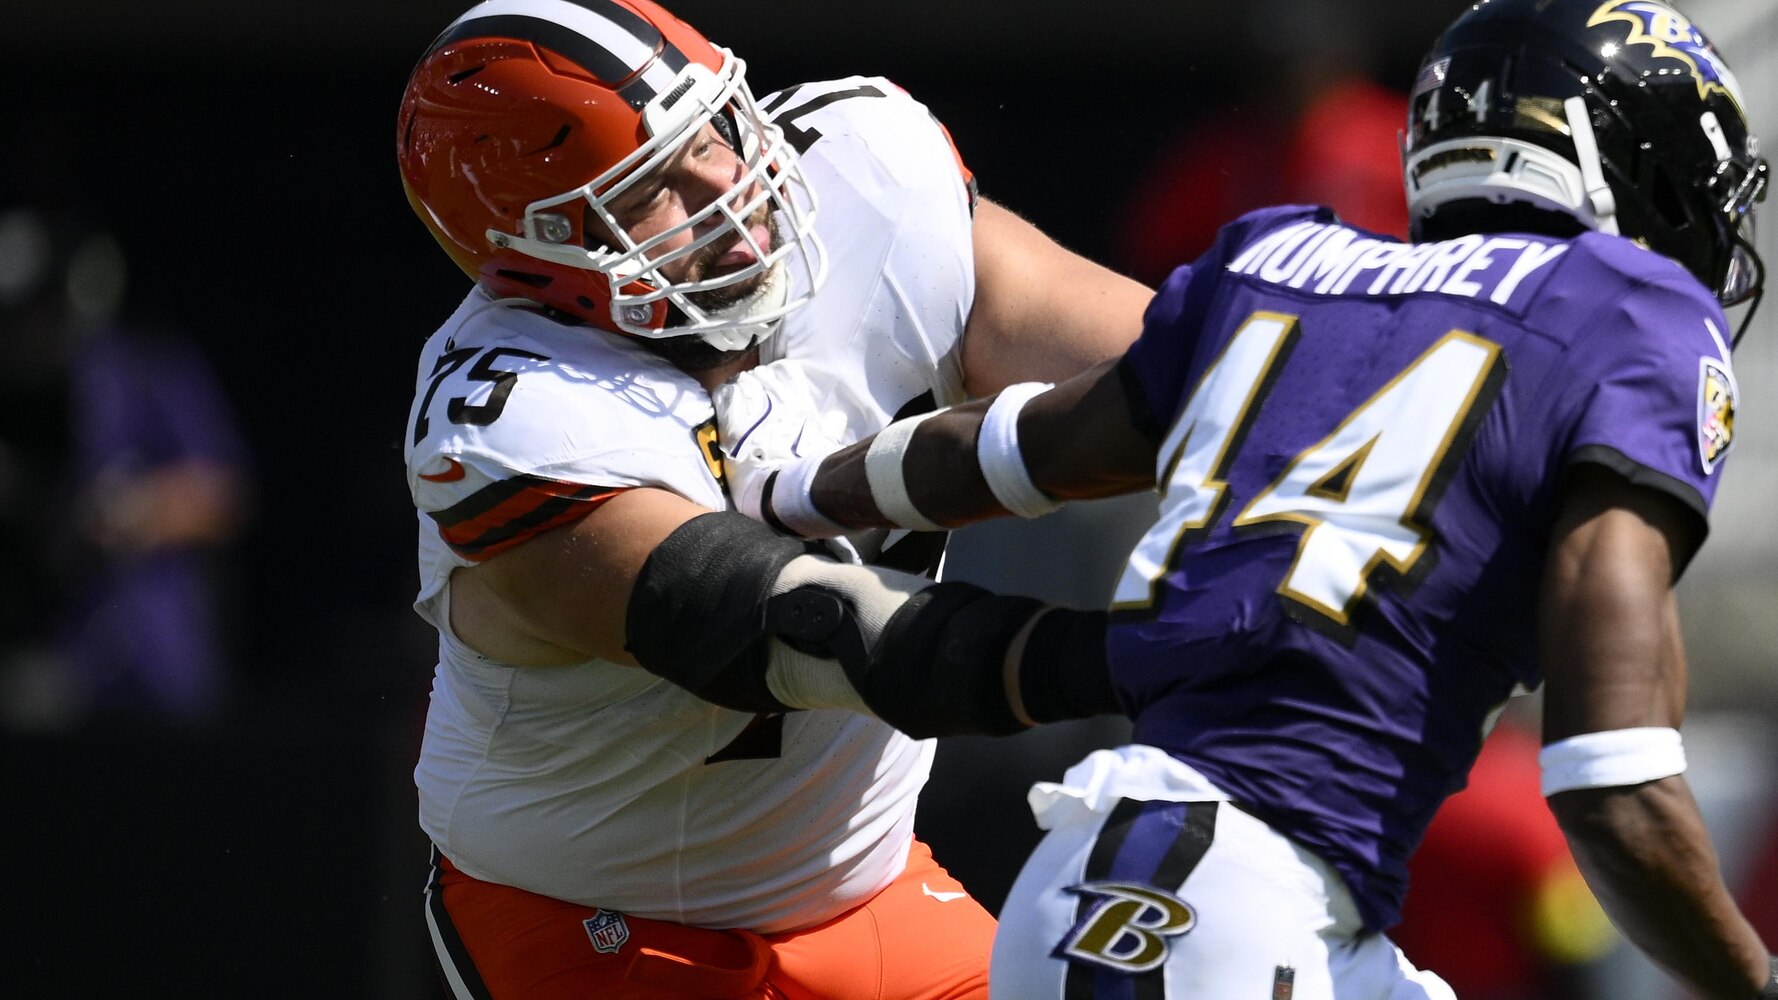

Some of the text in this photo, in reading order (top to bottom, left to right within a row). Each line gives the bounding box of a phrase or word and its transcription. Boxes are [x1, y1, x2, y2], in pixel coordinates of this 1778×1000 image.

[414, 346, 552, 448] 75
[1111, 310, 1508, 630] 44
[594, 923, 625, 948] NFL
[1049, 880, 1197, 973] B
